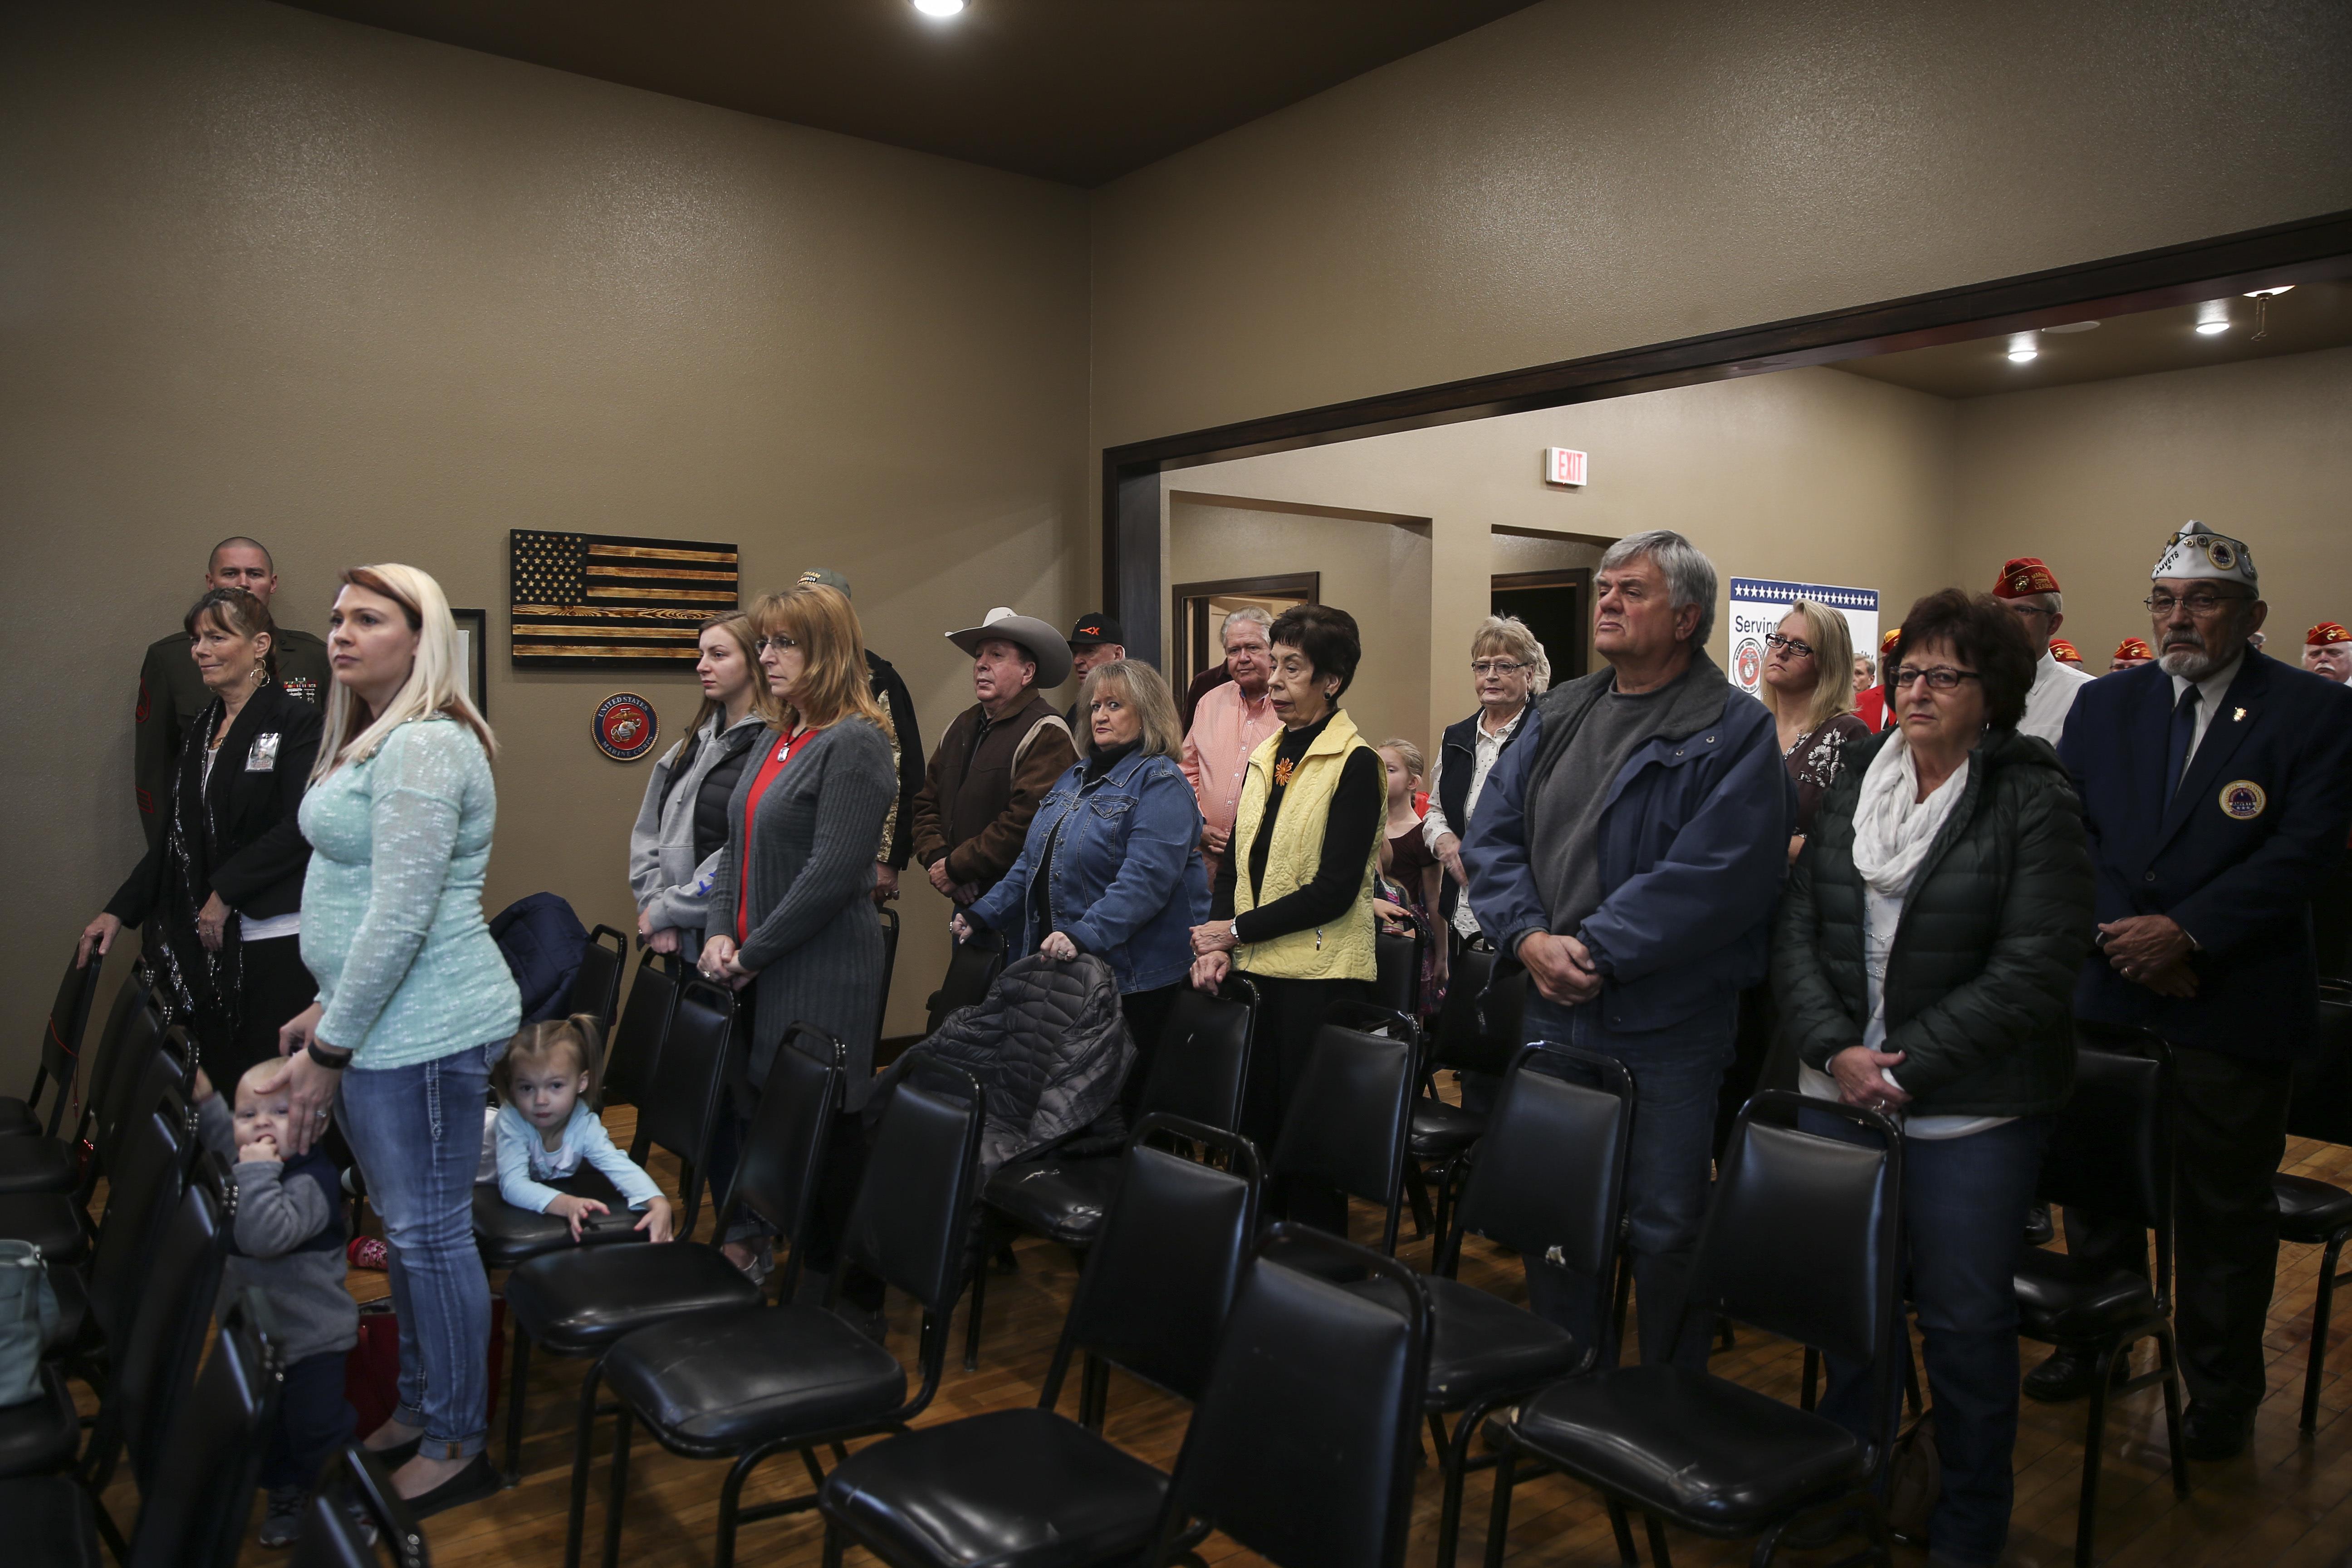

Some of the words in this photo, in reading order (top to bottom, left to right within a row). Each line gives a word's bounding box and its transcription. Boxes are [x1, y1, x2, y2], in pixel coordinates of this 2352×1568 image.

[1559, 451, 1583, 481] EXIT
[2156, 551, 2179, 576] AMVETS
[598, 697, 622, 717] UNITED
[623, 696, 649, 711] STATES
[602, 740, 632, 757] MARINE
[634, 736, 653, 755] CORPS
